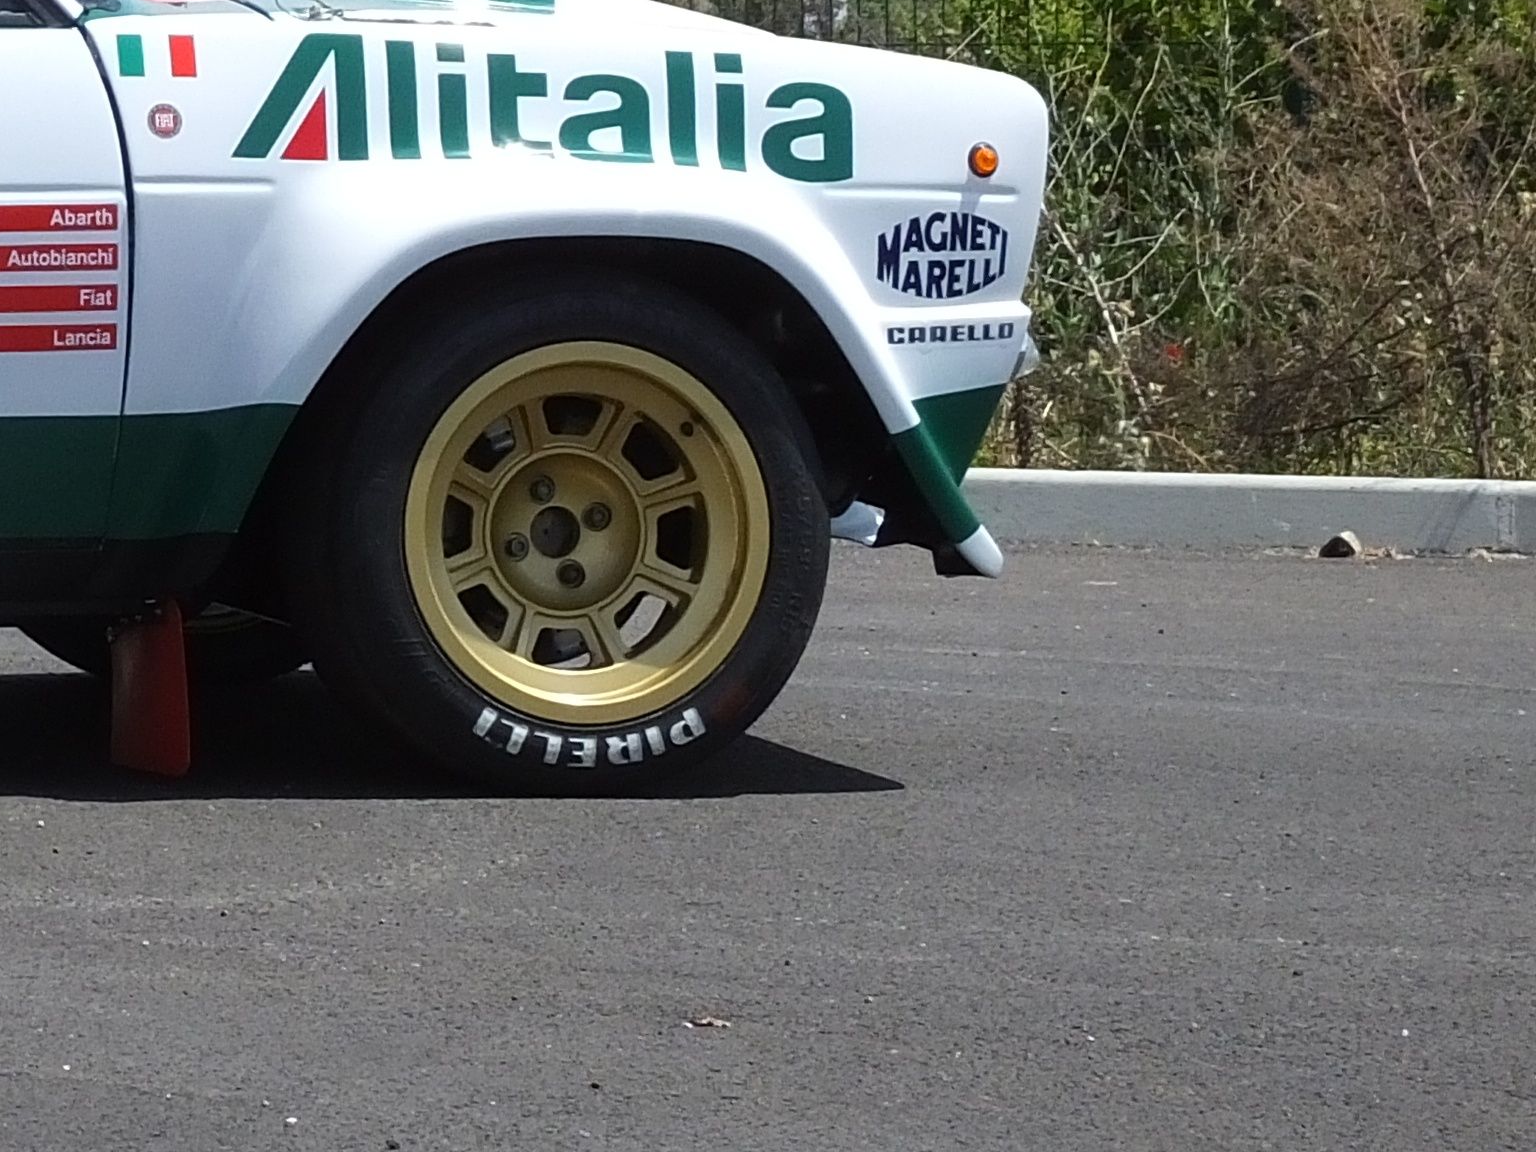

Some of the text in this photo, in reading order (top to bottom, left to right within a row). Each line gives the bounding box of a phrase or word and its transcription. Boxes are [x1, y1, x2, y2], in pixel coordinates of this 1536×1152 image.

[231, 33, 854, 183] Alitalia
[49, 208, 114, 227] Abarth
[877, 212, 1008, 259] MAGNETI
[6, 248, 114, 268] Autobianchi
[877, 252, 1006, 299] MARELLI
[79, 289, 113, 306] Fiat
[53, 329, 112, 346] Lancia
[887, 322, 1014, 345] CARELLO
[472, 707, 707, 768] PIRELLI
